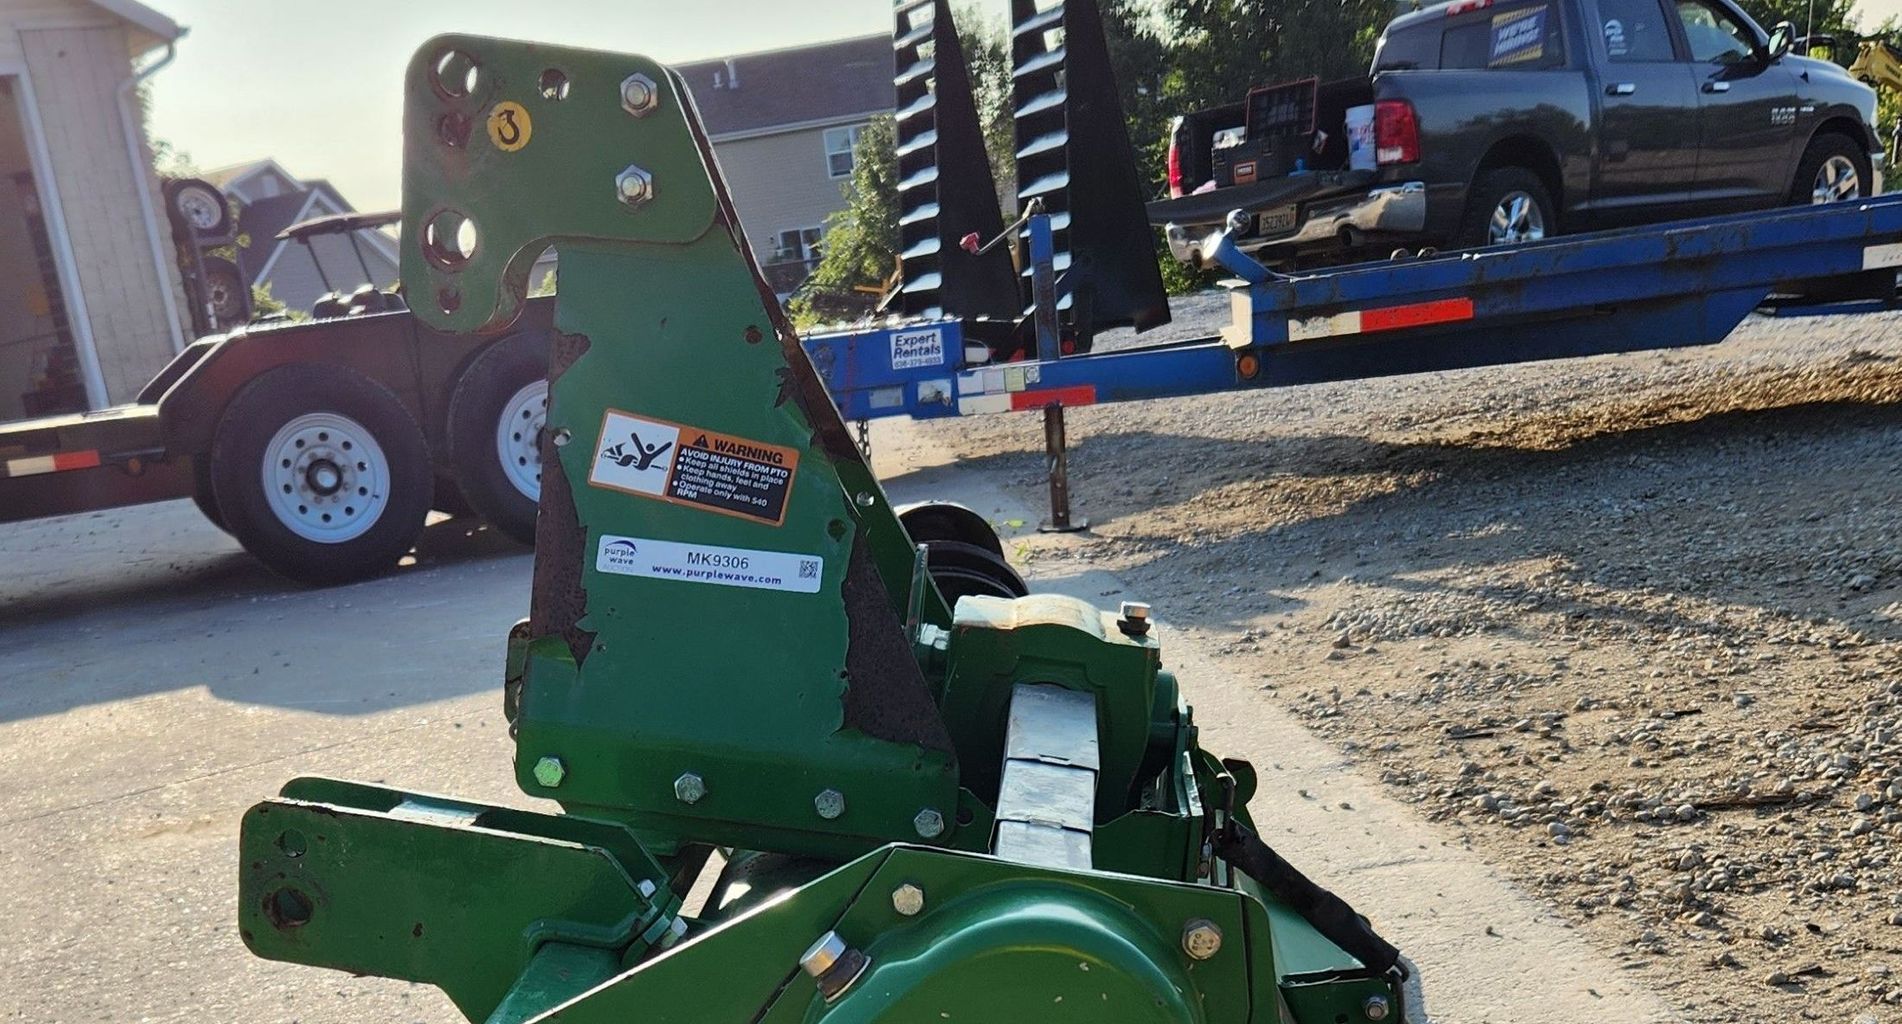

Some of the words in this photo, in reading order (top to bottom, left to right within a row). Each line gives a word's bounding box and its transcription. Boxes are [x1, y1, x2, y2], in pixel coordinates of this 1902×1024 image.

[894, 332, 937, 348] Expert
[893, 343, 941, 359] Rentals
[714, 439, 783, 464] WARNING
[681, 448, 709, 460] AVOID
[710, 454, 742, 468] INJURY
[743, 461, 770, 474] FROM
[770, 467, 788, 478] PTO
[685, 456, 706, 469] Keep
[708, 462, 719, 471] all
[719, 464, 750, 477] shields
[751, 470, 759, 479] in
[760, 474, 784, 486] place
[681, 473, 715, 488] clothing
[715, 481, 738, 493] away
[683, 464, 705, 477] Keep
[705, 469, 734, 483] hands,
[735, 475, 751, 486] feet
[752, 480, 769, 490] and
[677, 488, 697, 499] RPM
[679, 480, 713, 495] Operate
[713, 488, 732, 500] only
[733, 493, 751, 503] with
[751, 497, 768, 507] 540
[604, 547, 636, 557] purple
[609, 557, 634, 565] wave
[687, 551, 749, 570] MK9306
[652, 565, 782, 585] www.purplewave.com
